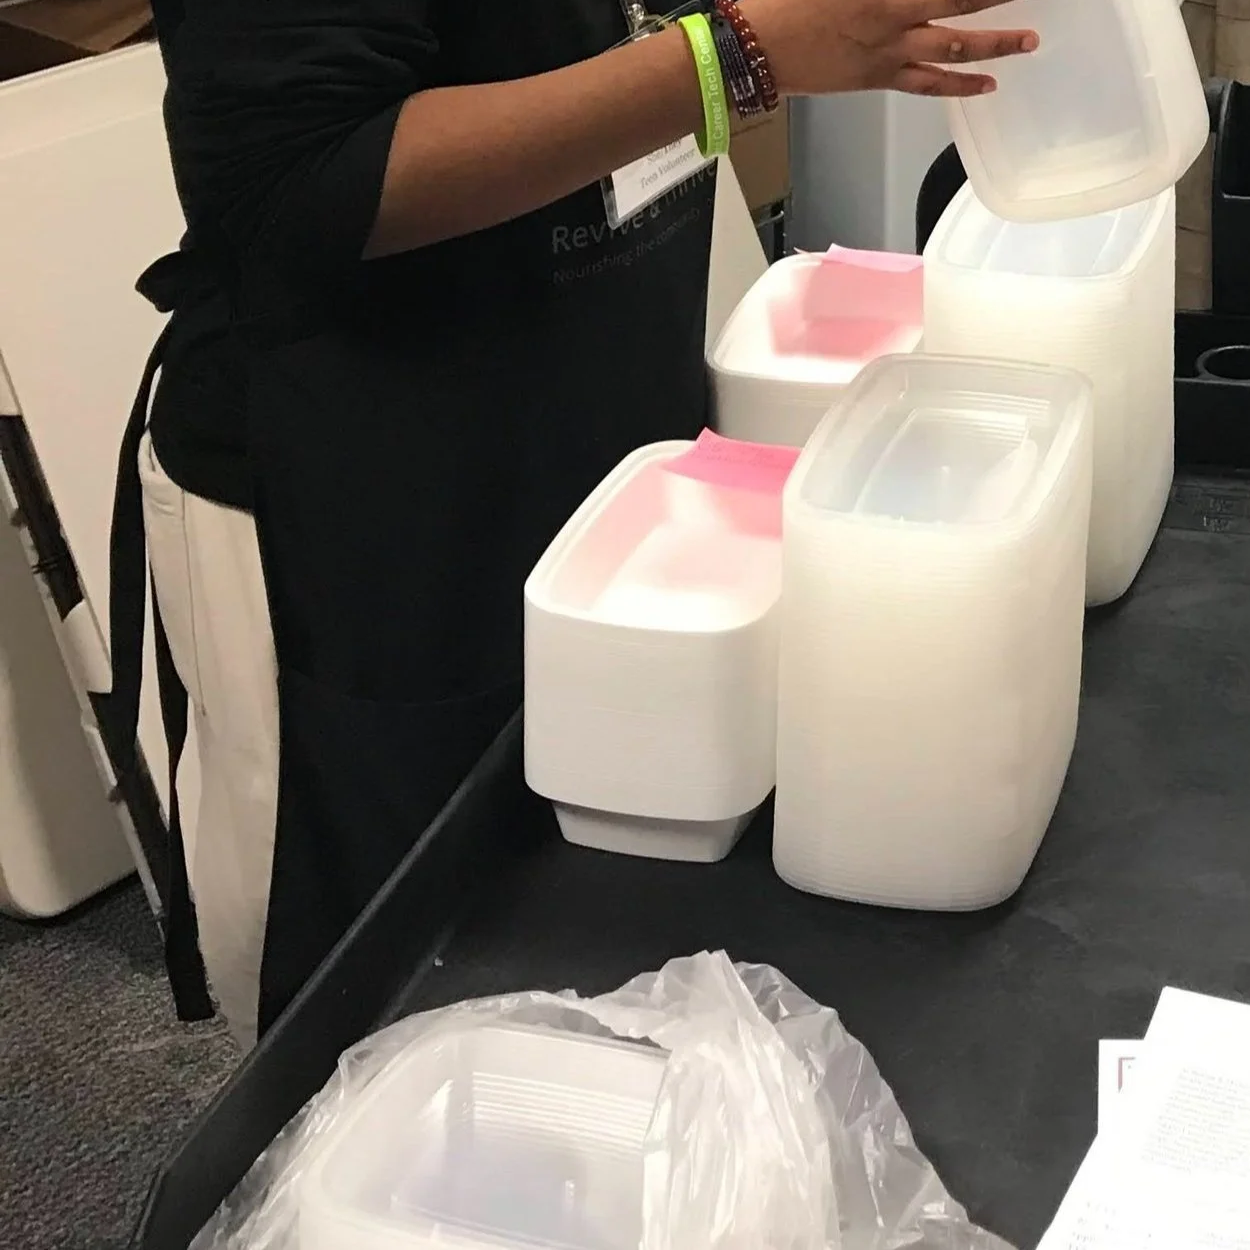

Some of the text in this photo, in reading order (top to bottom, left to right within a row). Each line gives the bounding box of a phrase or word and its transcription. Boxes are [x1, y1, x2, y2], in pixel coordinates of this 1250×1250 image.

[705, 67, 720, 99] Tech
[712, 101, 725, 141] Career
[551, 211, 645, 255] Revive
[552, 251, 634, 284] Nourishing
[635, 237, 655, 258] the
